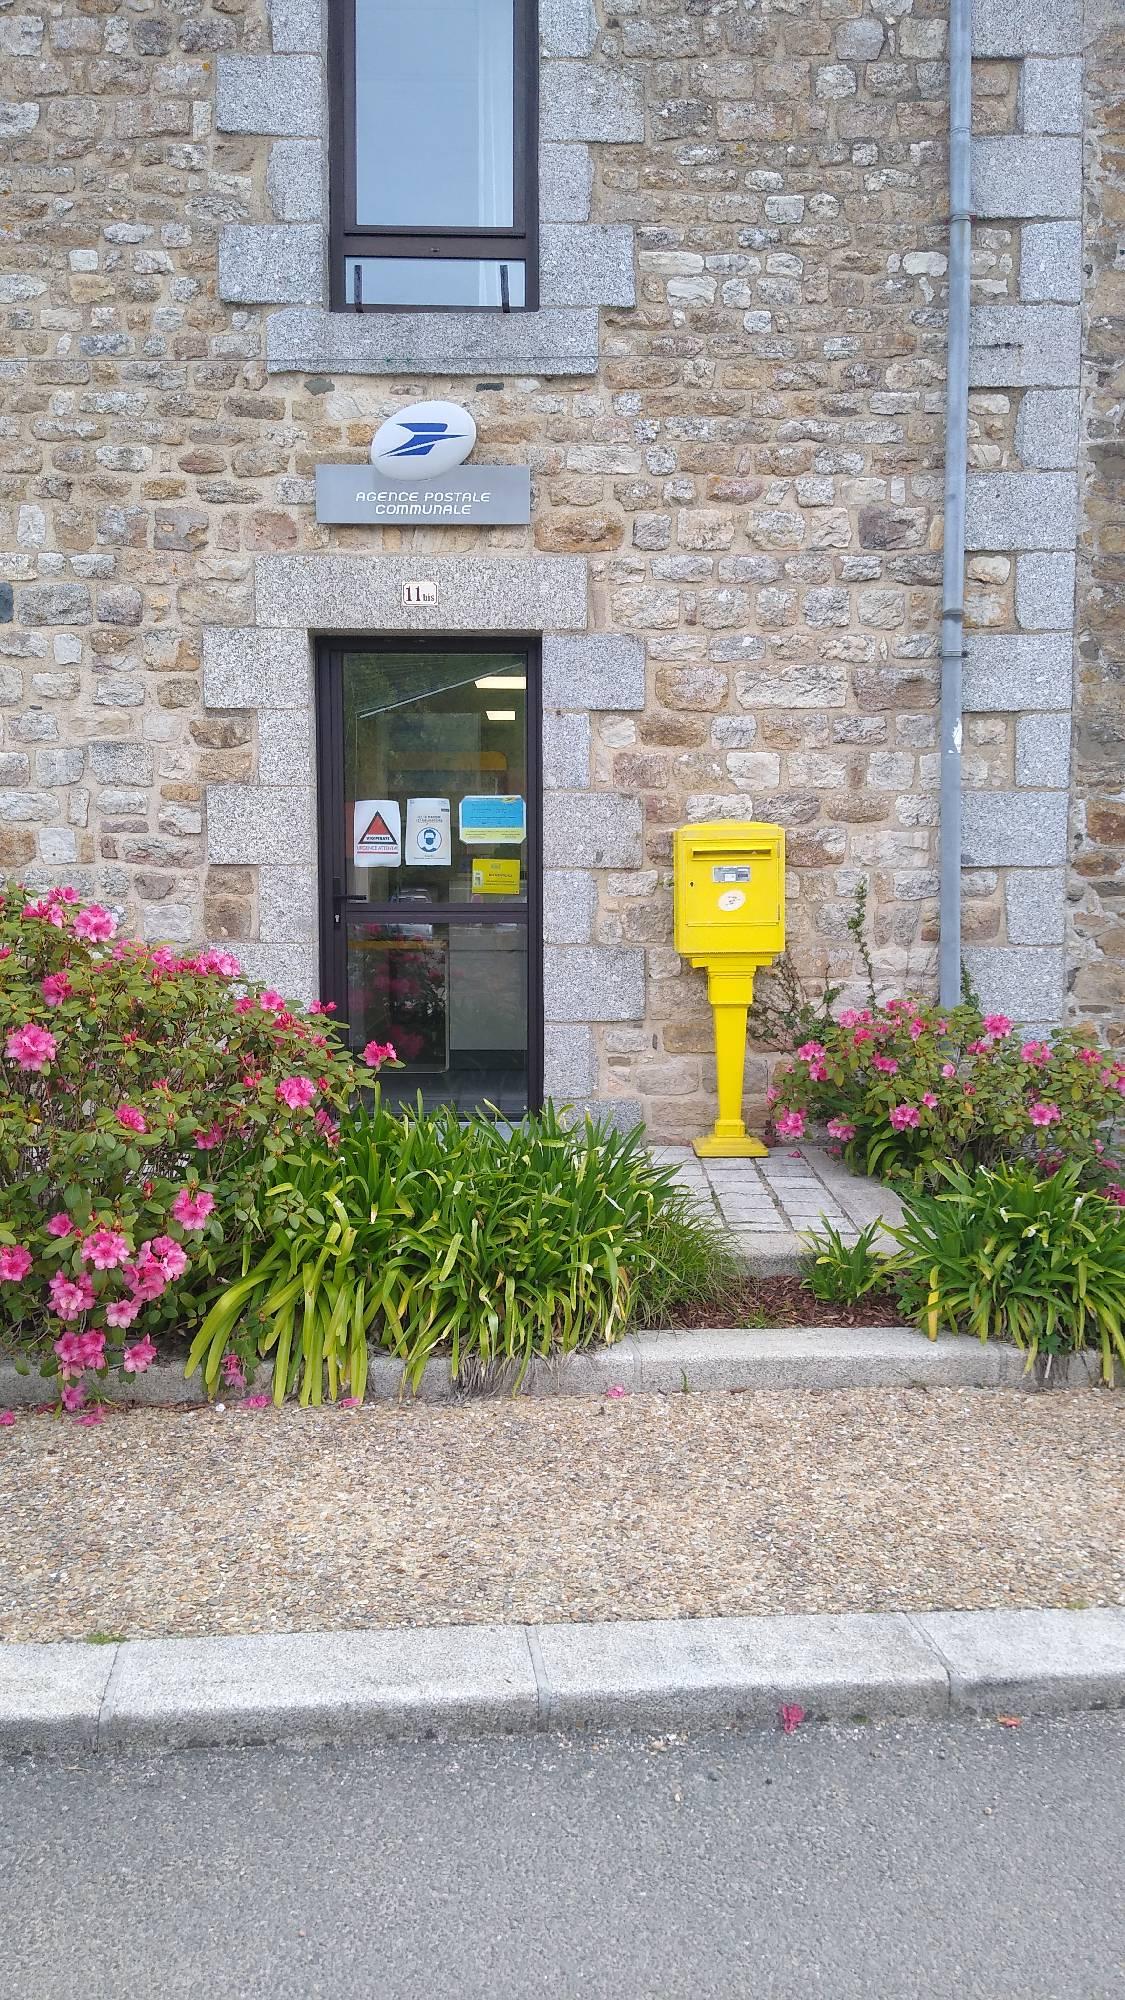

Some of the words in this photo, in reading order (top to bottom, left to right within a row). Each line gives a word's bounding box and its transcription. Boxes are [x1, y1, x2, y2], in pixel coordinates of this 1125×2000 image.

[355, 491, 418, 502] AGENCE
[424, 492, 491, 502] POSTALE
[375, 504, 472, 514] COMMUNALE
